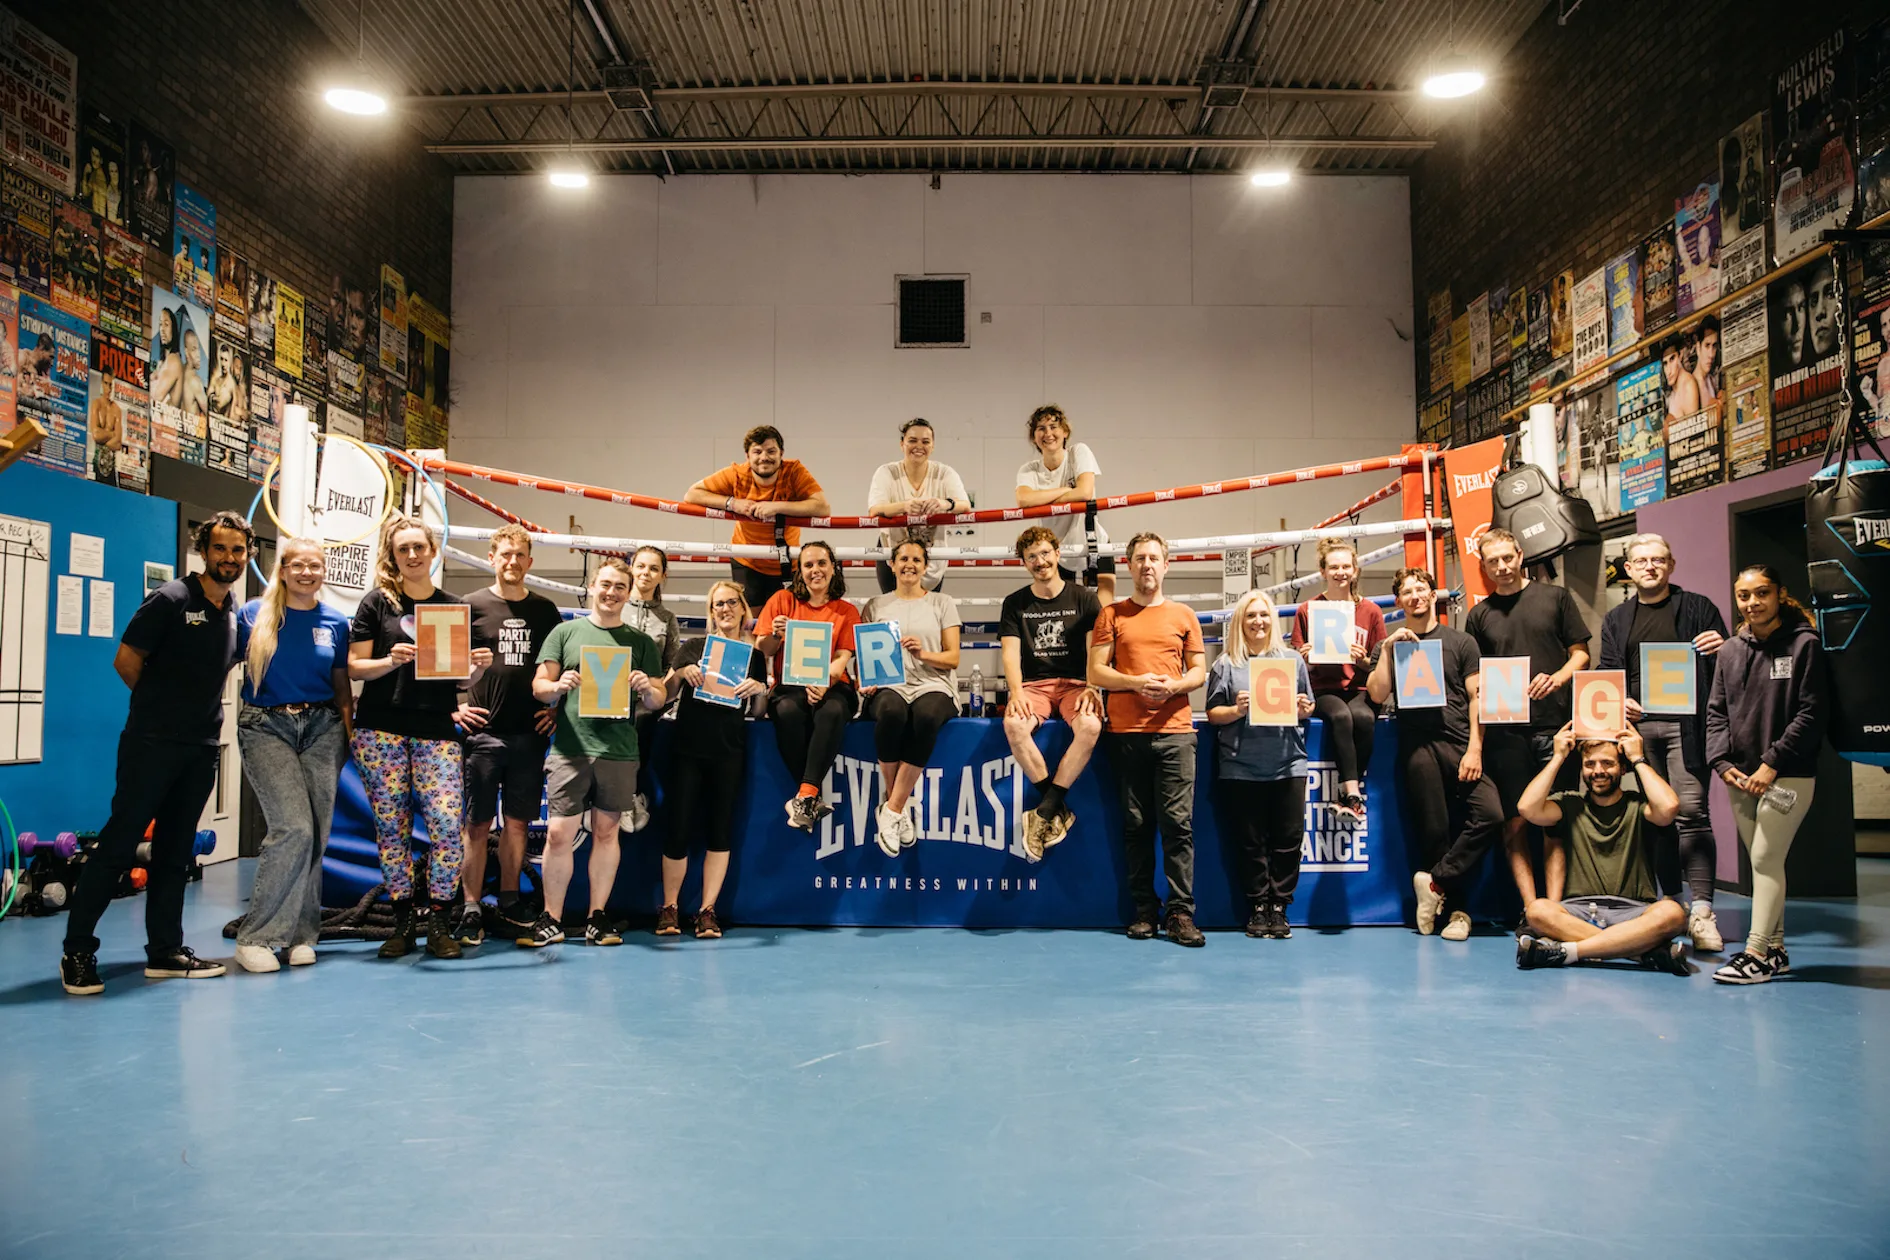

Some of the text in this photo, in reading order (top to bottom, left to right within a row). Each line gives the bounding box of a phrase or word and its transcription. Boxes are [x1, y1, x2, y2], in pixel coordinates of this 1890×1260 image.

[1777, 28, 1844, 95] HOLYFIELD
[1786, 61, 1836, 113] LEWIS
[30, 89, 70, 129] HALE
[2, 168, 51, 203] WORLD
[2, 192, 50, 226] BOXING
[327, 488, 376, 518] EVERLAST
[811, 516, 831, 527] EVERLAST
[859, 517, 879, 527] EVERLAST
[325, 558, 367, 573] IGHTING
[1226, 551, 1247, 560] EMPIRE
[325, 569, 365, 586] HANCE
[421, 611, 465, 672] T
[498, 641, 531, 653] ON THE
[499, 628, 531, 640] PARTY
[1314, 609, 1351, 654] R
[505, 653, 524, 666] HILL
[702, 640, 737, 700] L
[790, 627, 826, 679] E
[860, 631, 900, 680] R
[1402, 649, 1441, 697] A
[583, 652, 629, 710] Y
[1255, 668, 1291, 714] G
[1485, 665, 1523, 714] N
[1649, 652, 1689, 706] E
[1578, 680, 1621, 730] G
[815, 753, 1028, 860] EVRLAST
[1301, 831, 1369, 862] ANCE
[815, 876, 1037, 891] GREATNESS WITHIN
